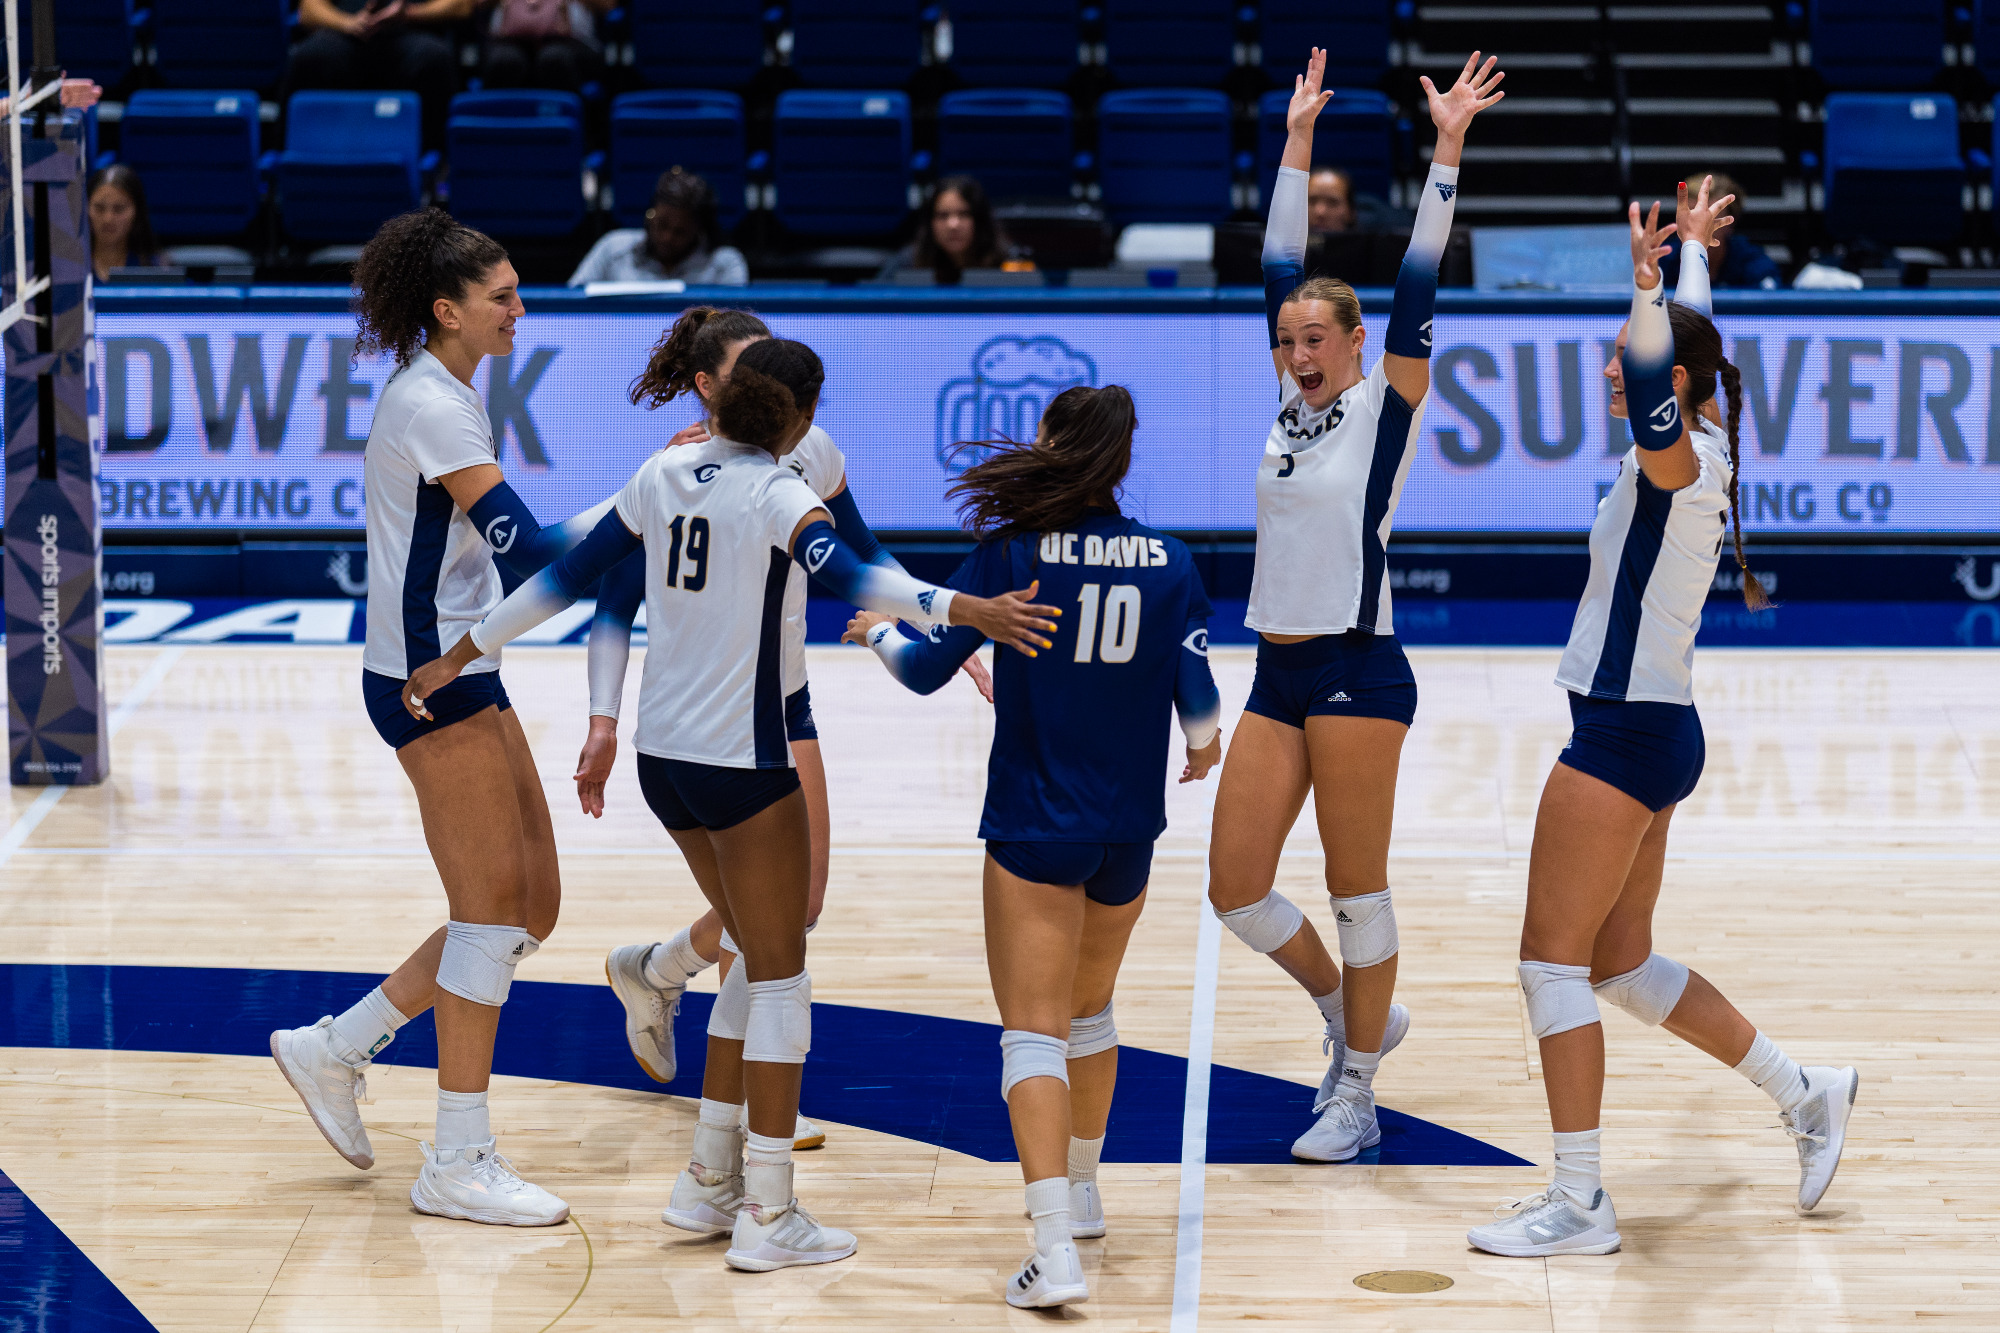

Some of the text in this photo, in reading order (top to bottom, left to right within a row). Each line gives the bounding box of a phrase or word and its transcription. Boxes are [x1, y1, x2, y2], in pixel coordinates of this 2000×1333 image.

[667, 514, 710, 593] 19
[1040, 531, 1168, 568] UC DAVIS
[37, 514, 63, 675] sports imports
[1074, 583, 1141, 663] 10
